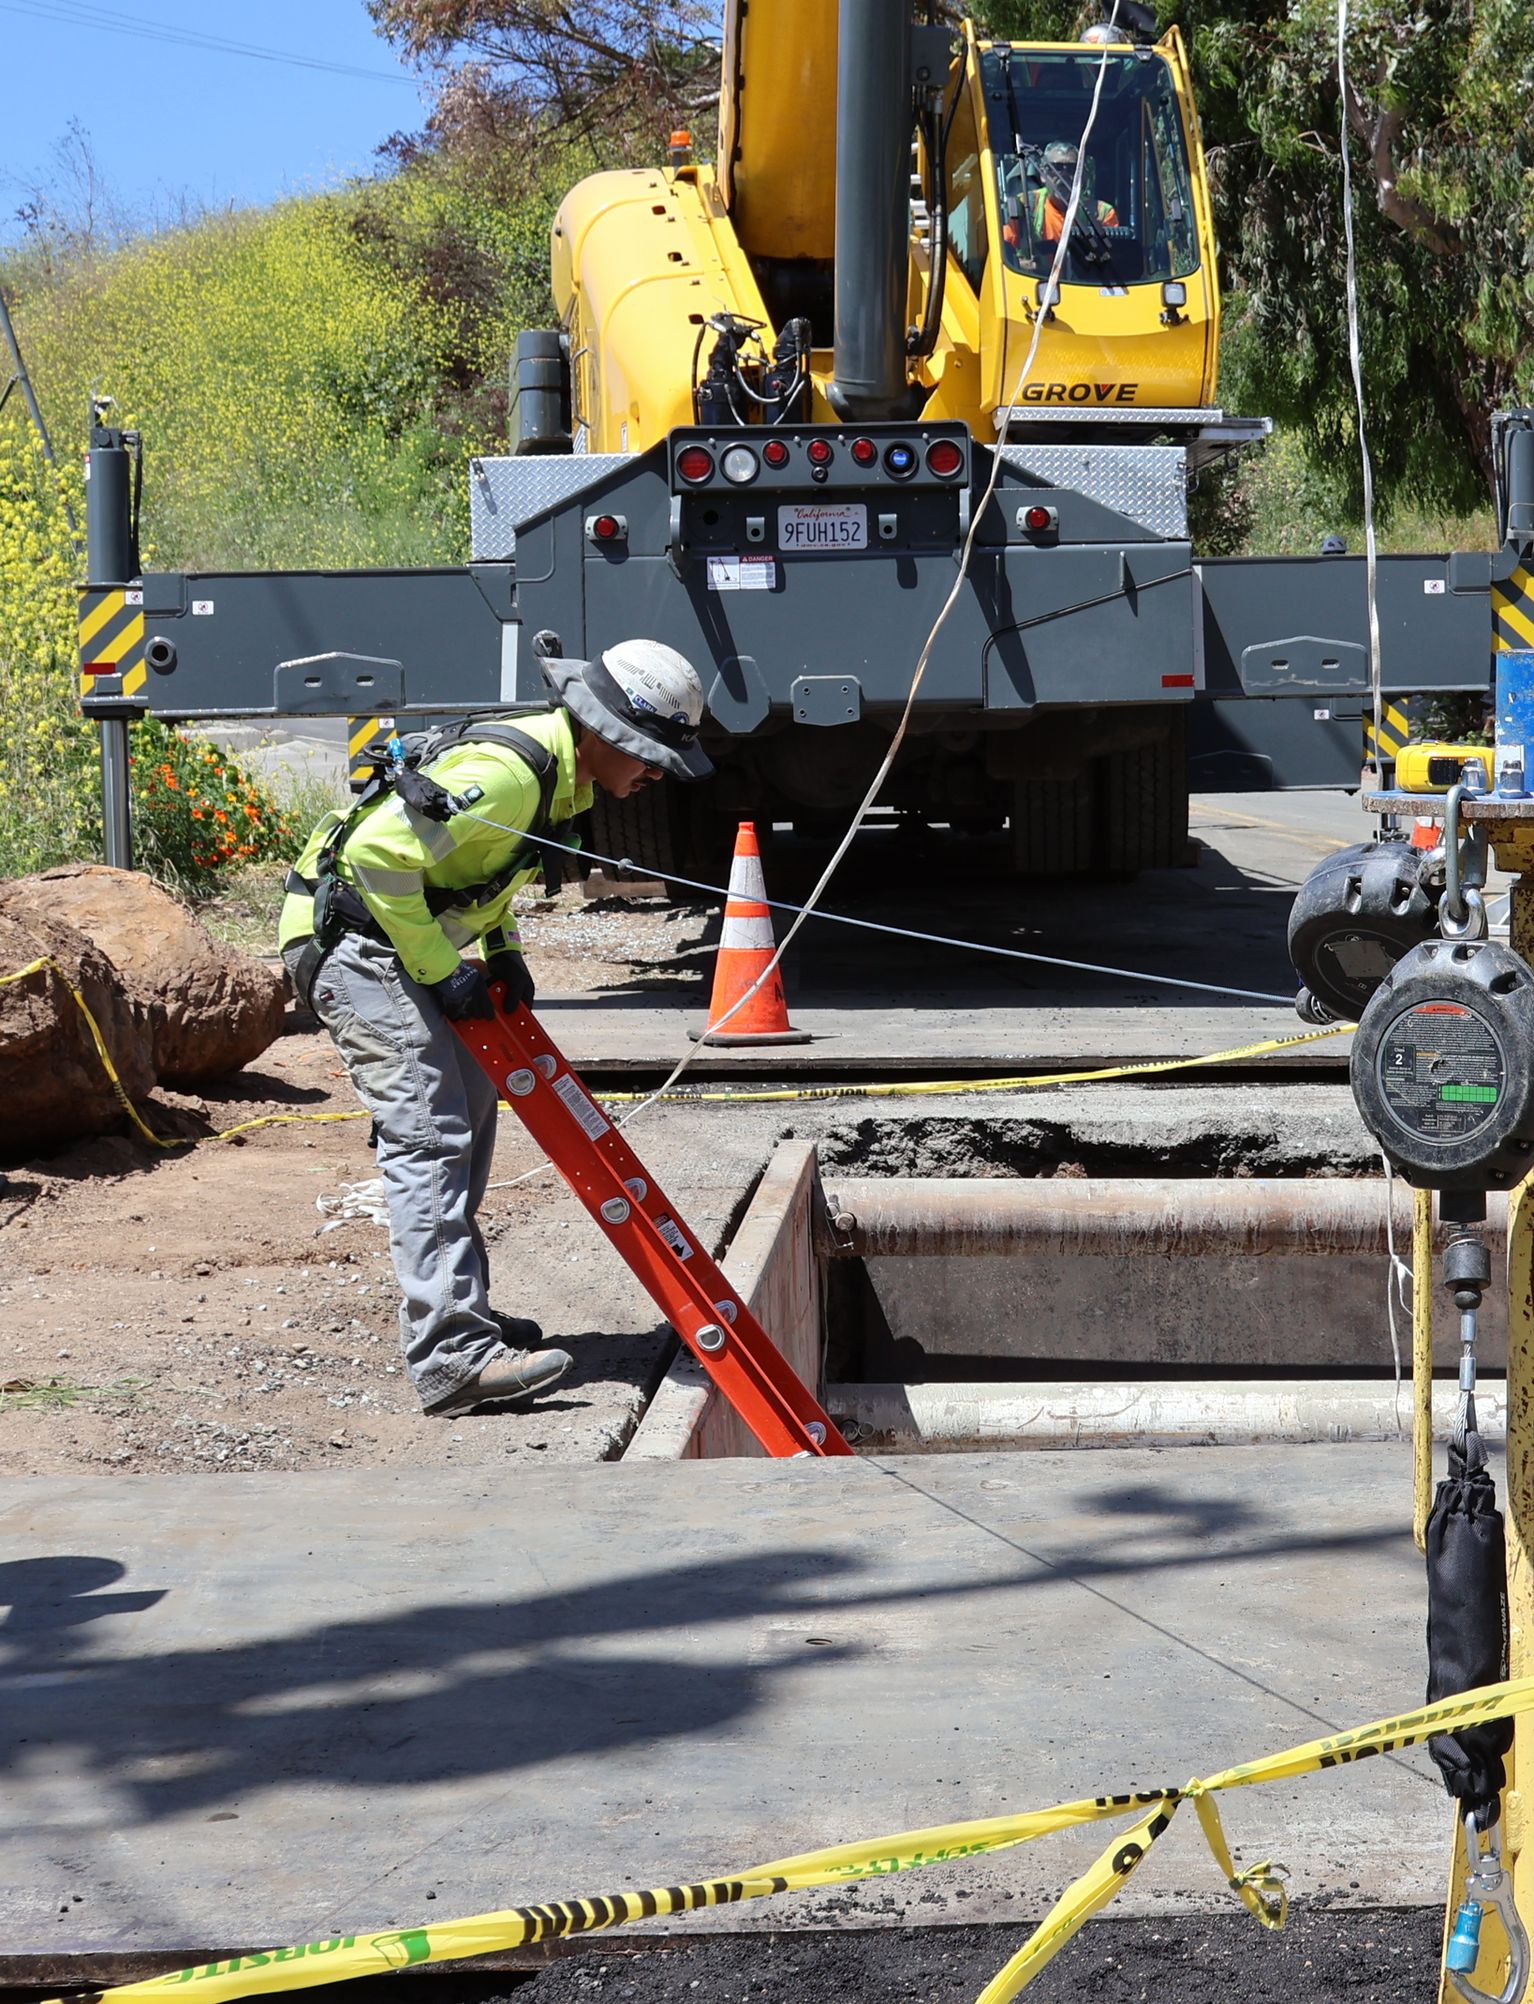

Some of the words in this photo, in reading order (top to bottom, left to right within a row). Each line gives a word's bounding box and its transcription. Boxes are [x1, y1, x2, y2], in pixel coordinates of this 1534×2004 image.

[1022, 383, 1139, 402] GROVE
[797, 508, 847, 521] California
[784, 521, 861, 543] 9FUH152
[1395, 1054, 1403, 1065] 2
